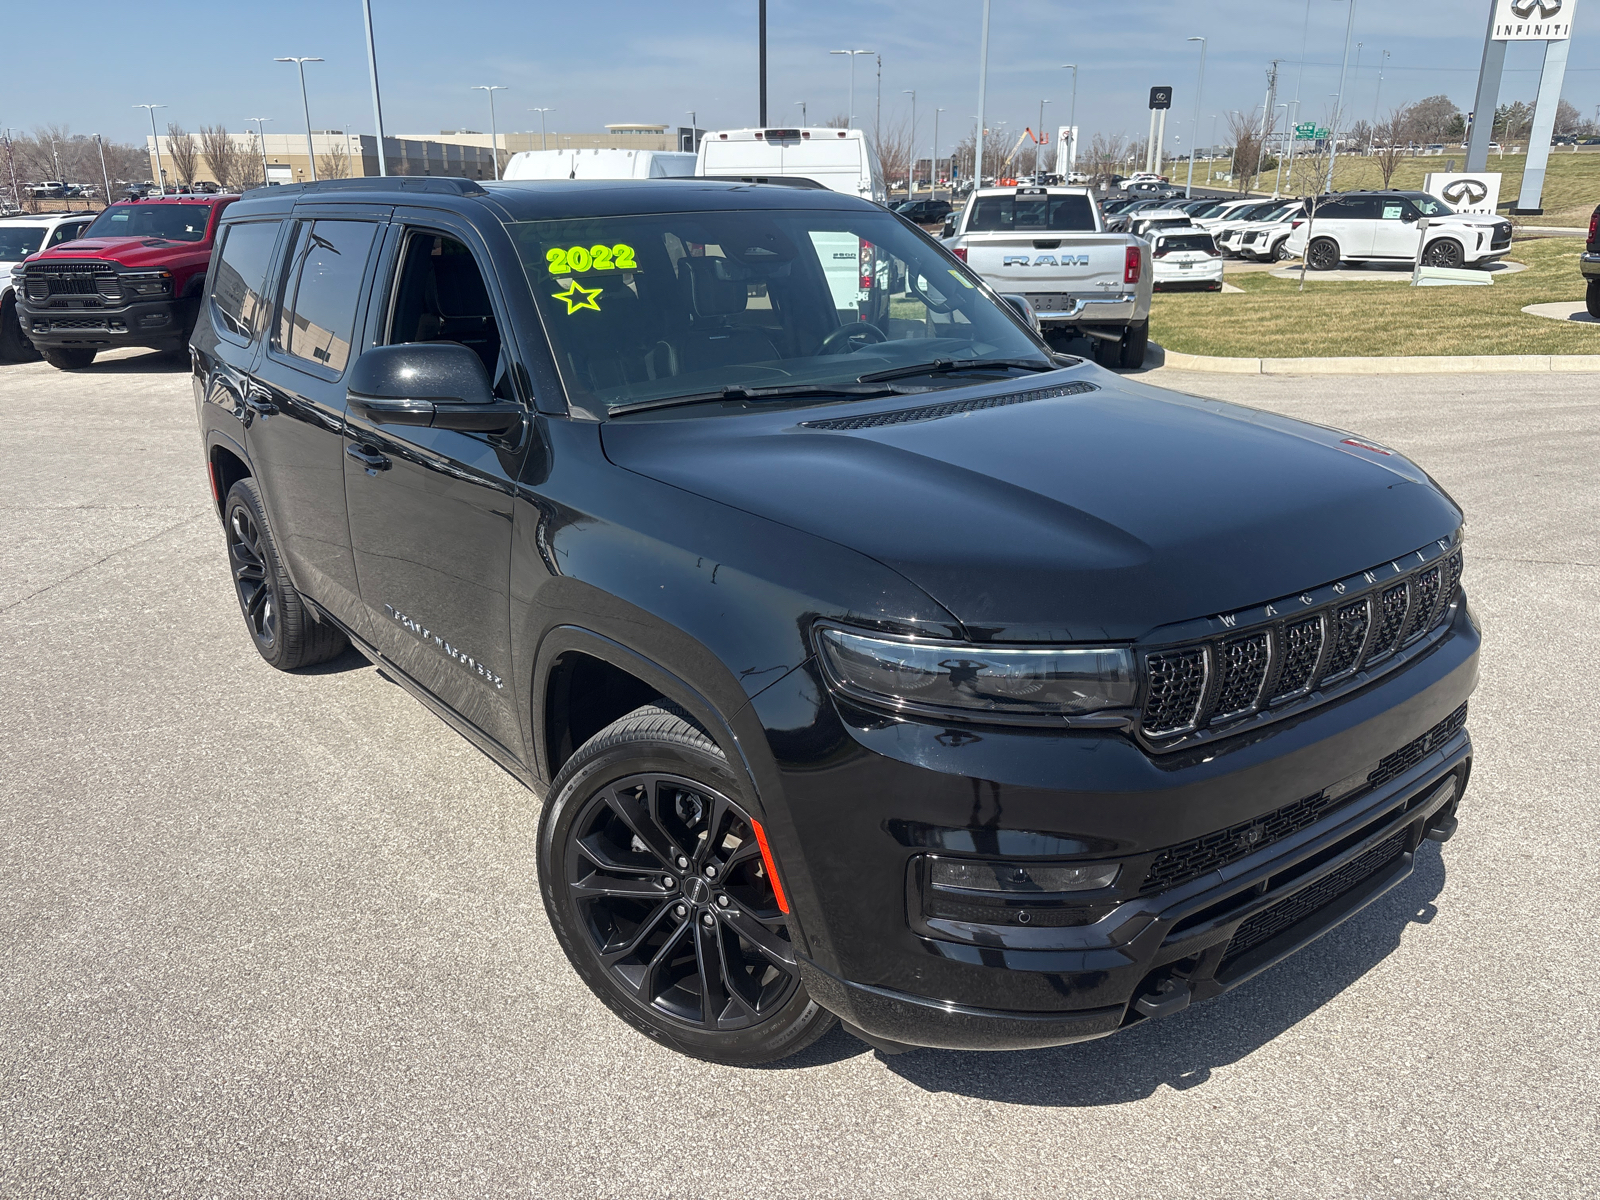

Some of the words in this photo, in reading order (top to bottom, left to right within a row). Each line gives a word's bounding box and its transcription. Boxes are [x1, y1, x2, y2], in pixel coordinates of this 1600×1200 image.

[1496, 24, 1569, 36] INFINITI
[546, 243, 638, 275] 2022
[1003, 254, 1090, 267] RAM
[1217, 539, 1449, 629] WAGONEER
